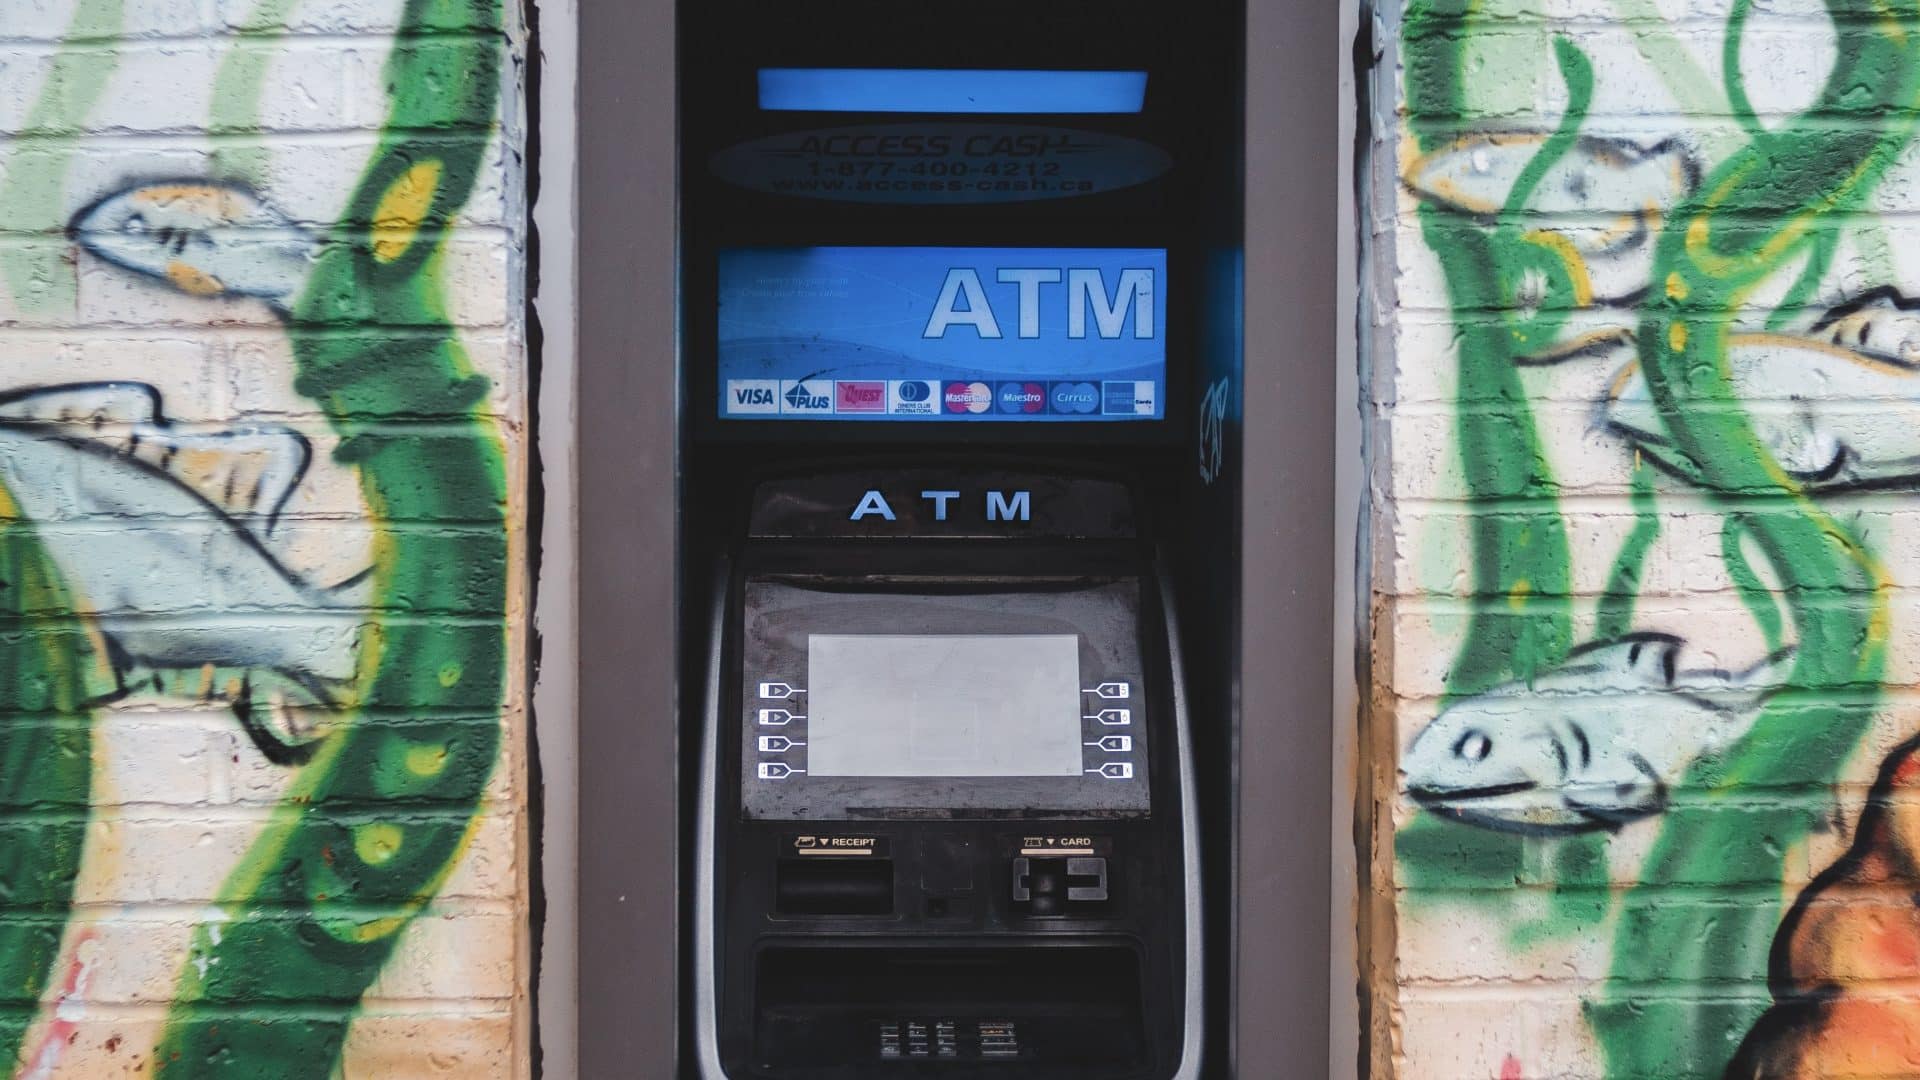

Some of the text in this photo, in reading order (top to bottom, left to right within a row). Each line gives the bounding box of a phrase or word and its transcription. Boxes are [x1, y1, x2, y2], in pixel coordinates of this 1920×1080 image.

[800, 134, 1072, 157] ACCESS CASH
[808, 160, 1062, 176] 1-877-400-4212
[770, 177, 1094, 192] www.access-cash.ca
[921, 267, 1155, 340] ATM
[735, 388, 774, 405] VISA
[796, 395, 830, 409] PLUS
[1002, 392, 1041, 402] Maestro
[1057, 392, 1093, 402] Cirrus
[831, 838, 876, 847] RECEIPT
[1060, 837, 1091, 846] CARD
